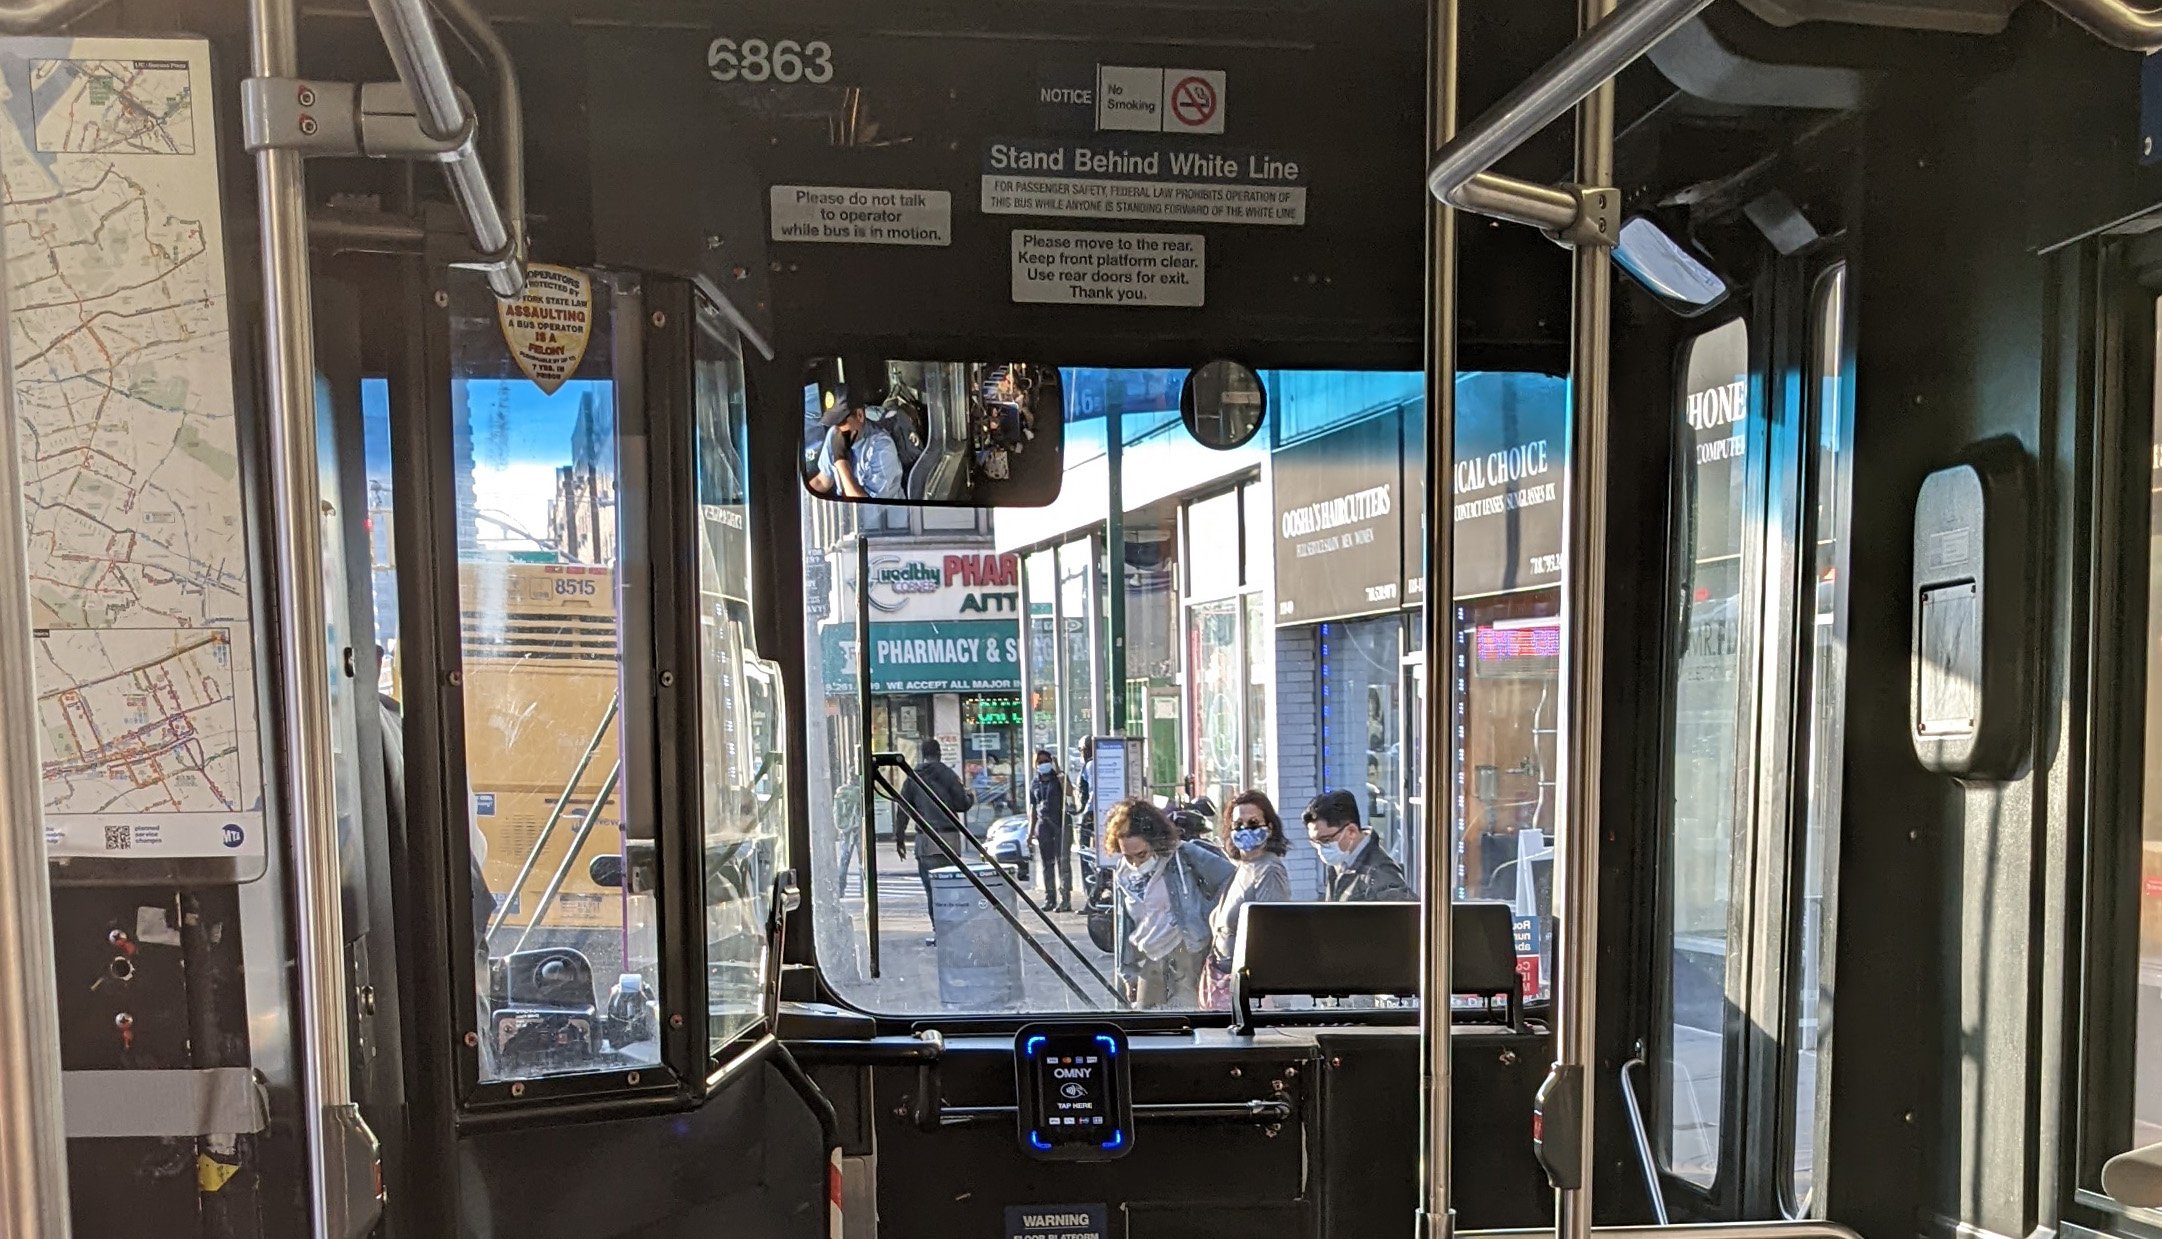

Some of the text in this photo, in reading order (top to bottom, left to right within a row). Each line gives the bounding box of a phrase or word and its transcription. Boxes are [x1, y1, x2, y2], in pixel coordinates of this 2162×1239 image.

[708, 37, 834, 84] 6863
[1040, 88, 1092, 104] NOTICE
[1108, 84, 1123, 95] No
[1107, 100, 1155, 114] Smoking
[990, 144, 1299, 180] Stand Behind White Line
[796, 190, 926, 207] Please do not talk
[995, 181, 1013, 192] FOR
[1015, 181, 1070, 194] PASSENGER
[1111, 185, 1150, 198] FEDERAL
[1153, 187, 1173, 198] LAW
[1176, 188, 1223, 200] PROHIBITS
[1226, 190, 1276, 202] OPERATION
[1279, 192, 1290, 203] OF
[820, 208, 902, 224] to operator
[992, 197, 1296, 219] THIS BUS WHILE ANYONE IS STANDING FORWARD OF THE WHITE LINE
[781, 224, 941, 241] while bus is in motion.
[1023, 234, 1193, 252] Please move to the rear.
[1018, 251, 1198, 268] Keep front platform clear.
[1027, 268, 1189, 285] Use rear doors for exit.
[1070, 285, 1147, 301] Thank you.
[546, 296, 569, 306] STATE
[572, 299, 588, 308] LAW
[506, 304, 586, 323] ASSAULTING
[517, 320, 535, 329] BUS
[537, 322, 584, 334] OPERATOR
[535, 331, 557, 343] IS A
[528, 343, 565, 355] FELONY
[1686, 381, 1747, 431] HONE
[1454, 440, 1548, 494] ICAL CHOICE
[1320, 484, 1391, 530] HAIRCUTTERS
[1483, 495, 1505, 516] LENSES
[943, 554, 1019, 587] PHAR
[554, 578, 596, 596] 8515
[877, 638, 979, 664] PHARMACY
[986, 639, 1001, 663] &
[886, 682, 904, 690] WE
[906, 680, 948, 690] ACCEPT
[950, 680, 970, 689] ALL
[972, 680, 1011, 689] MAJOR
[223, 829, 241, 842] MTA
[1054, 1068, 1092, 1079] OMNY
[1022, 1213, 1089, 1227] WARNING
